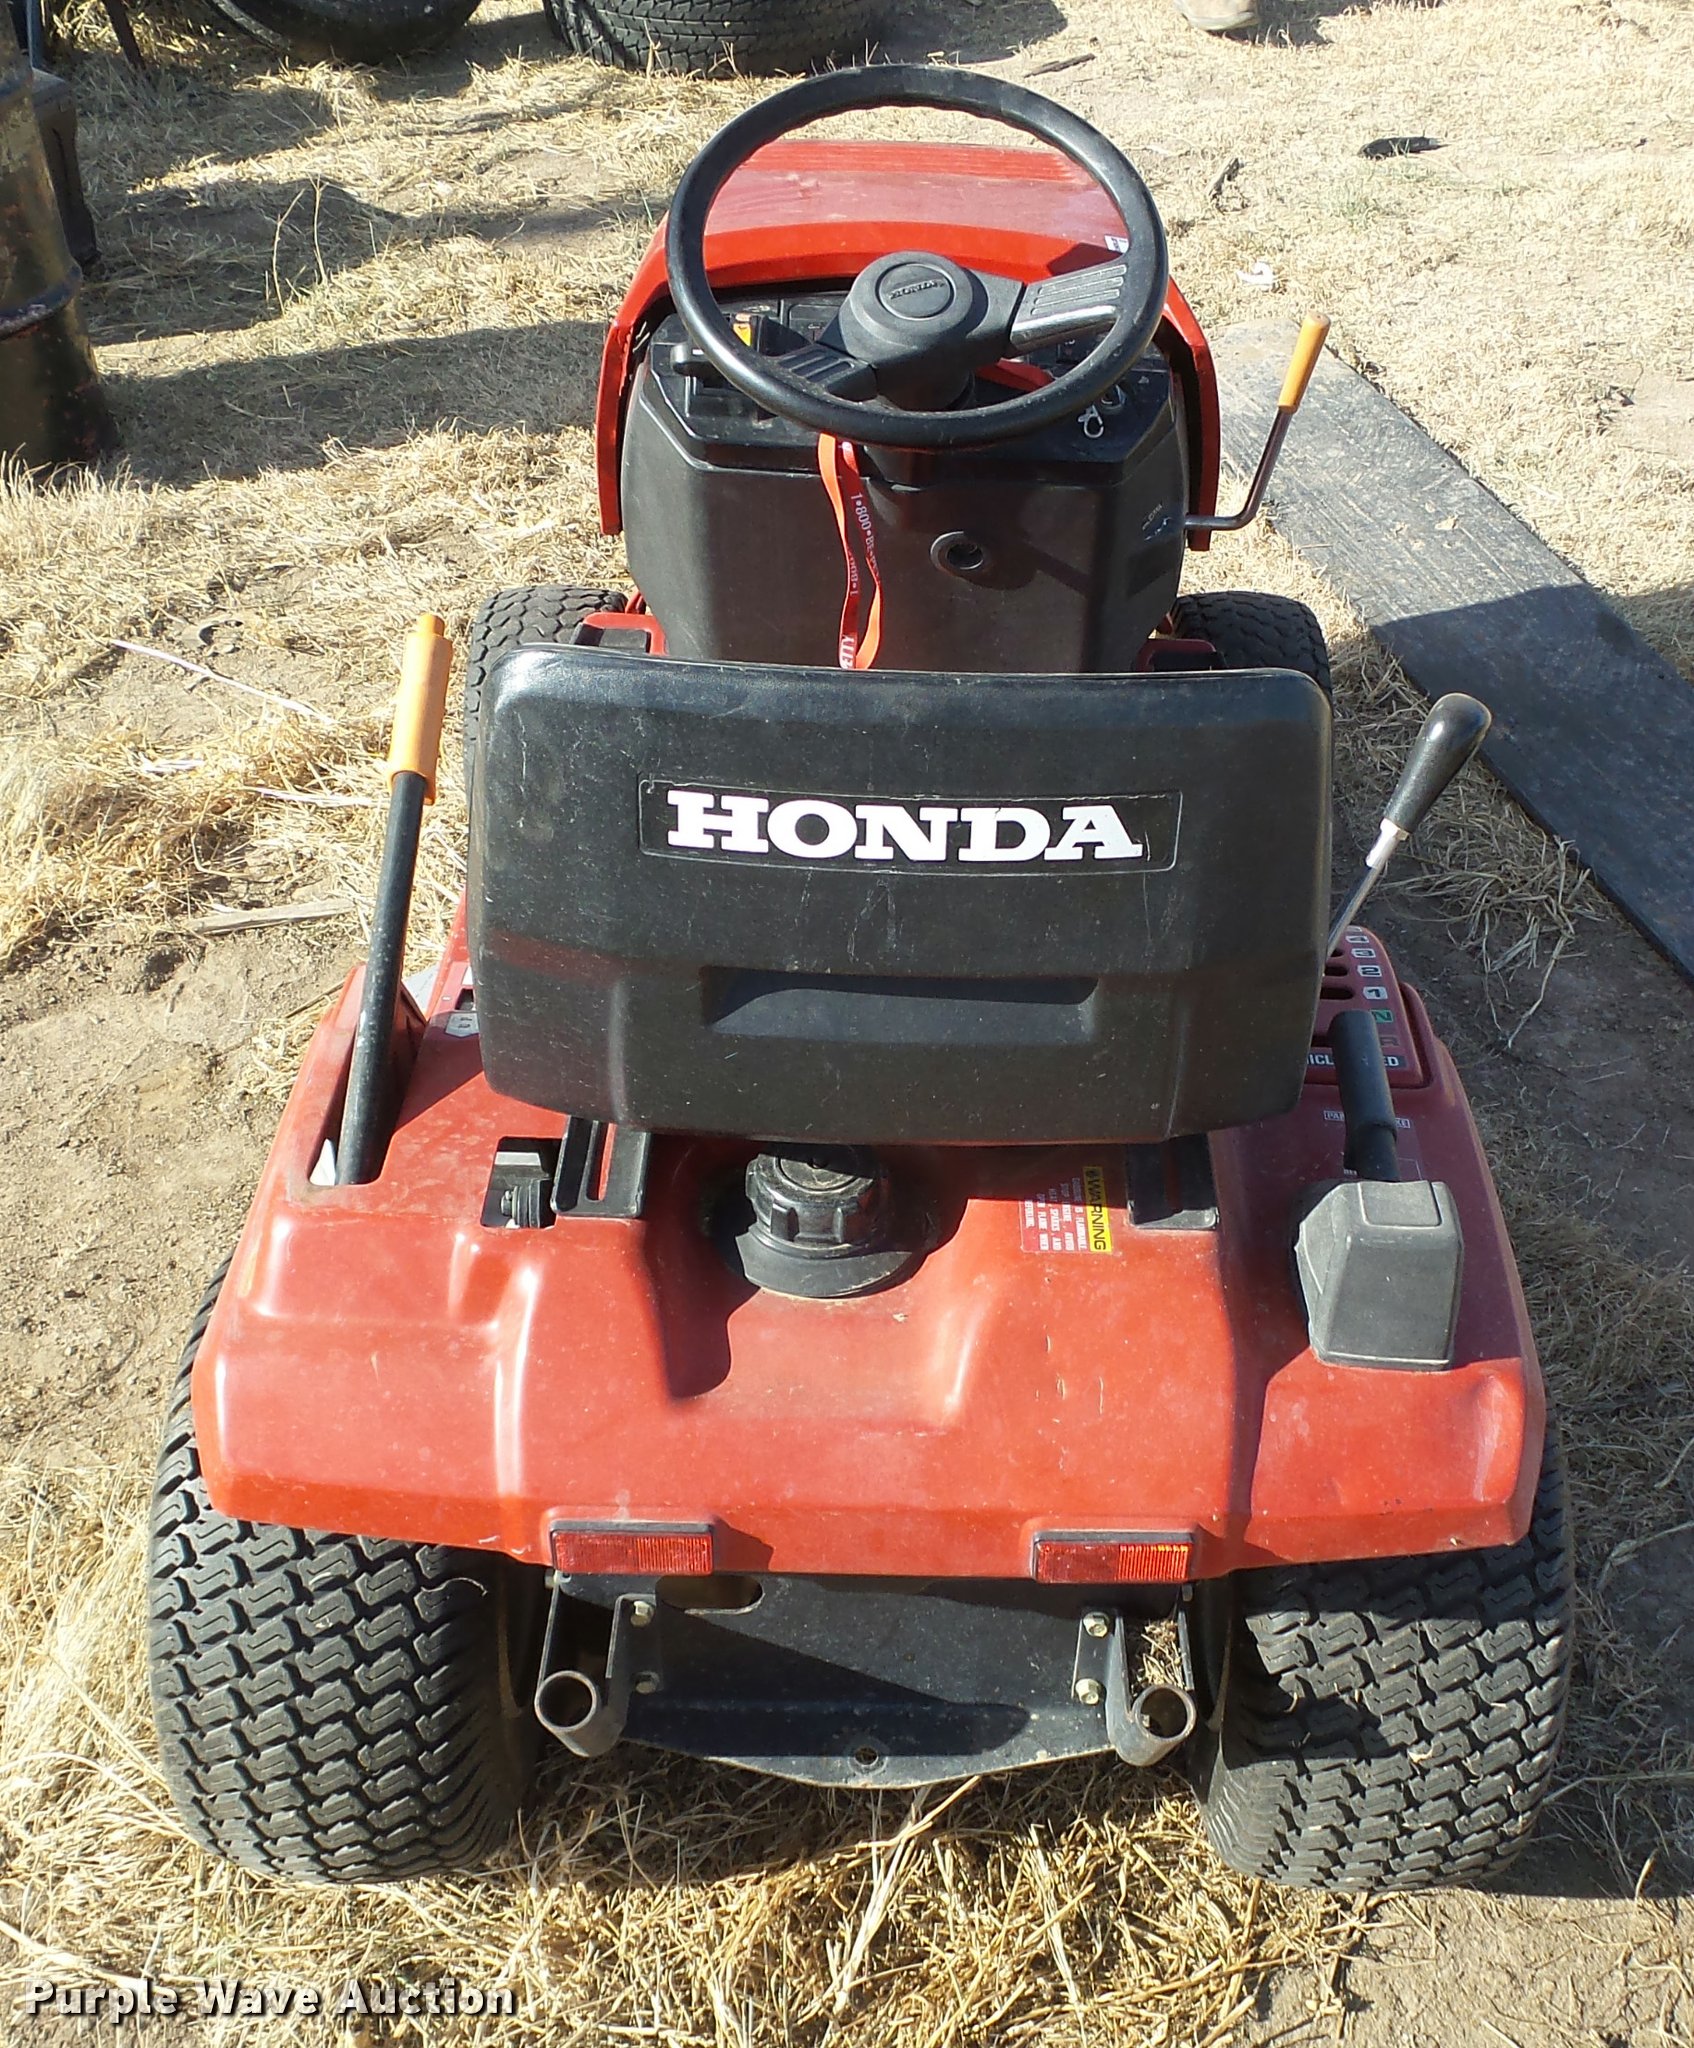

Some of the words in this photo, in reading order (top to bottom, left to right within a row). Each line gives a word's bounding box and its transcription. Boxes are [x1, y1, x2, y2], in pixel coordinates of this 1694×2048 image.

[667, 790, 1144, 862] HONDA
[1361, 967, 1381, 976] 2
[1371, 1011, 1393, 1021] N
[1088, 1178, 1107, 1251] WARNING
